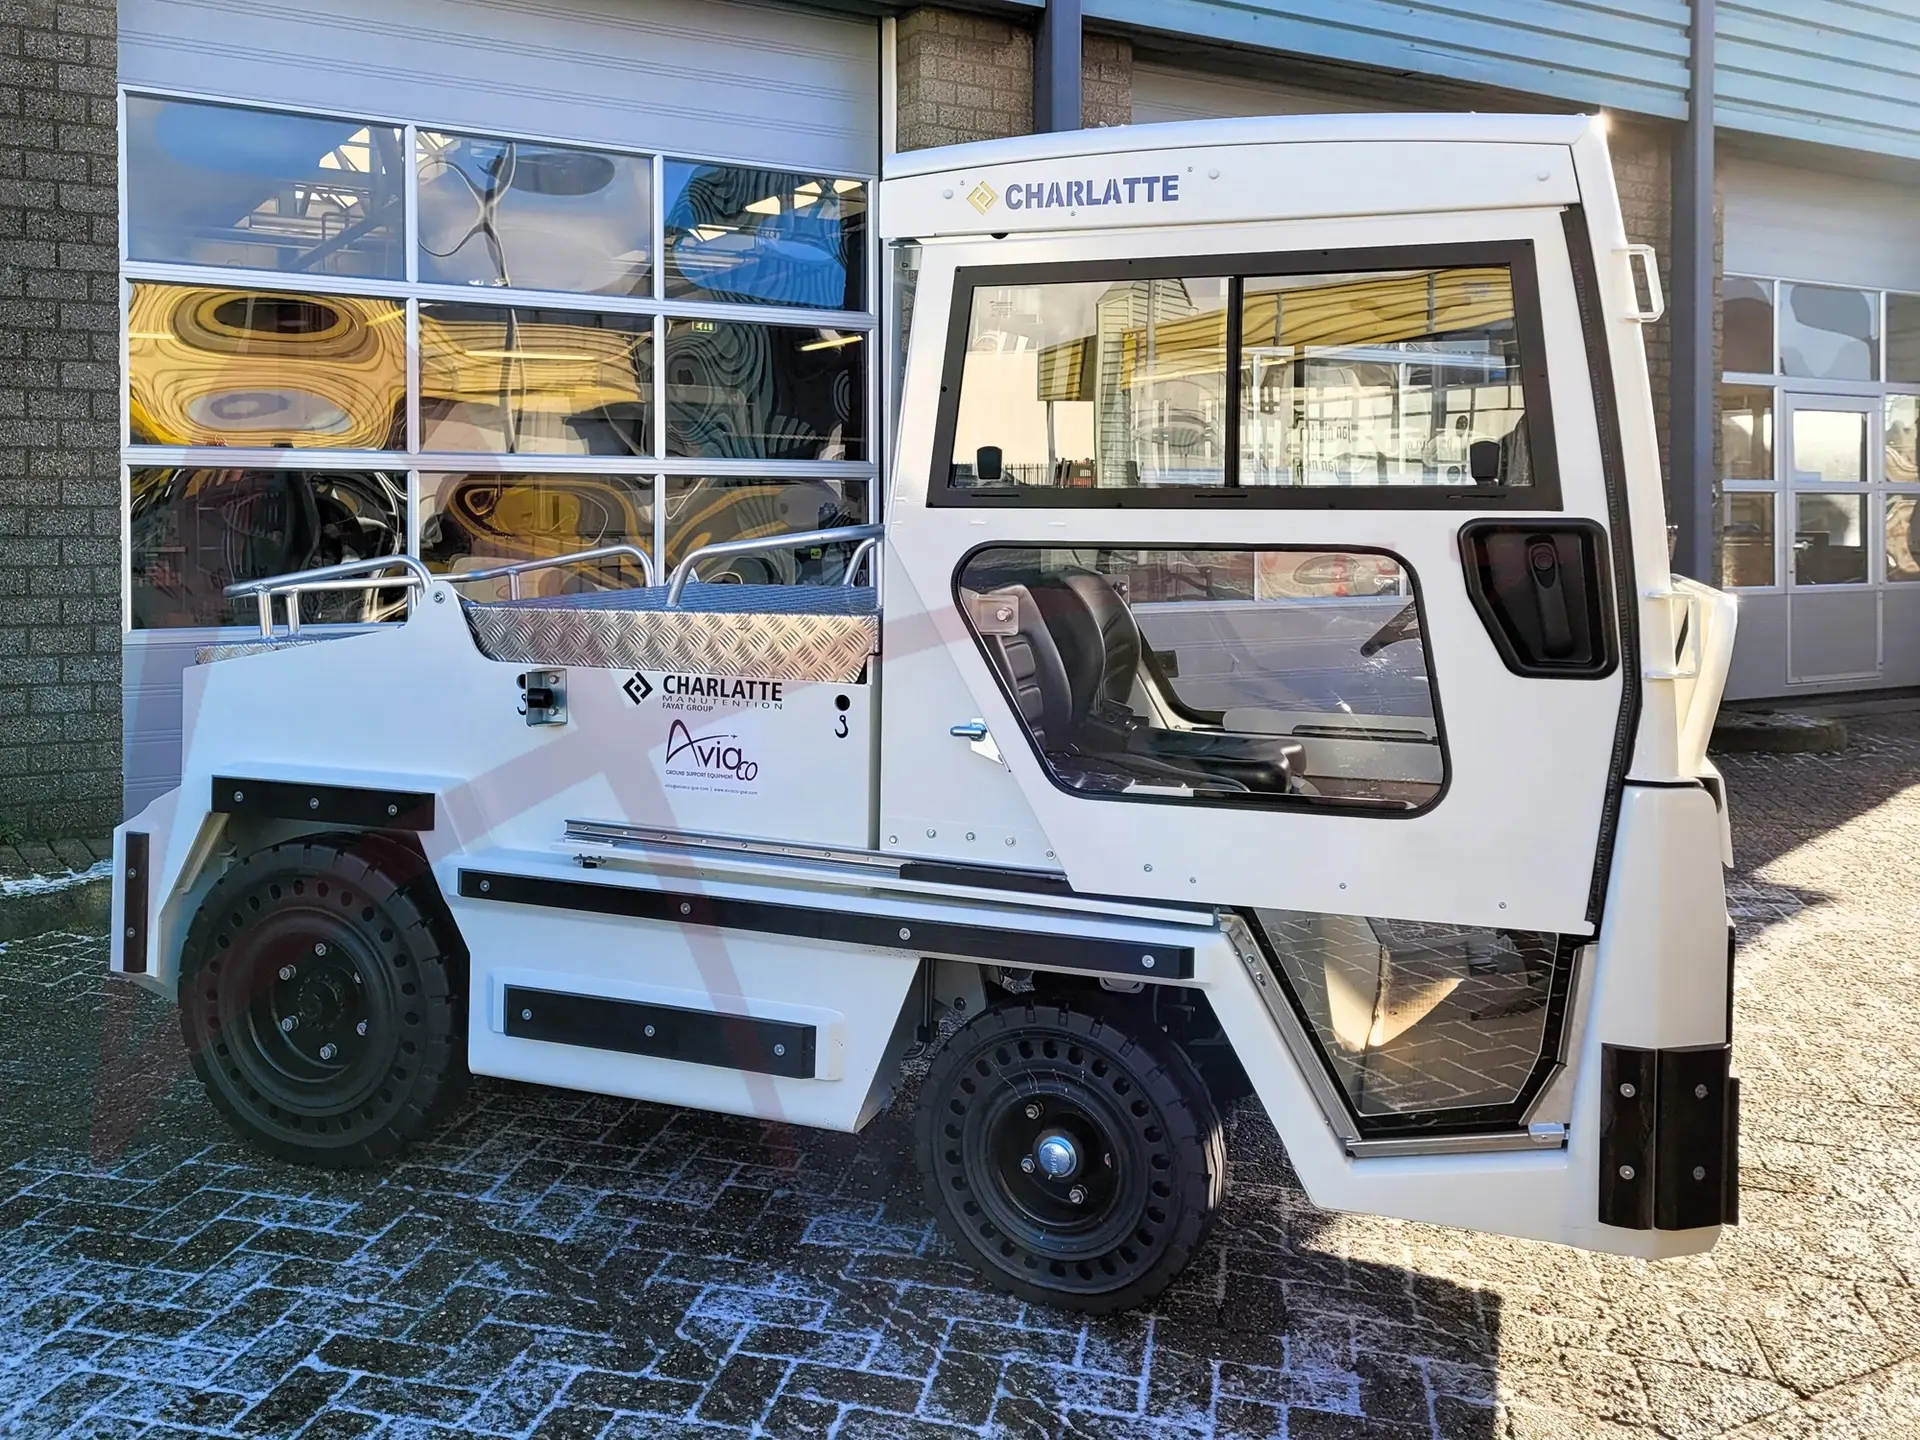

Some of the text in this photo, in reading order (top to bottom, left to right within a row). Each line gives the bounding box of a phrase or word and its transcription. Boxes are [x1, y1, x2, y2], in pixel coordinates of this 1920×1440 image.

[1005, 174, 1179, 210] CHARLATTE
[662, 674, 783, 702] CHARLATTE
[662, 695, 783, 710] MANUTENTION
[662, 703, 714, 713] FAYAT GROUP
[665, 769, 686, 777] GROUND
[707, 772, 734, 780] EQUIPMENT
